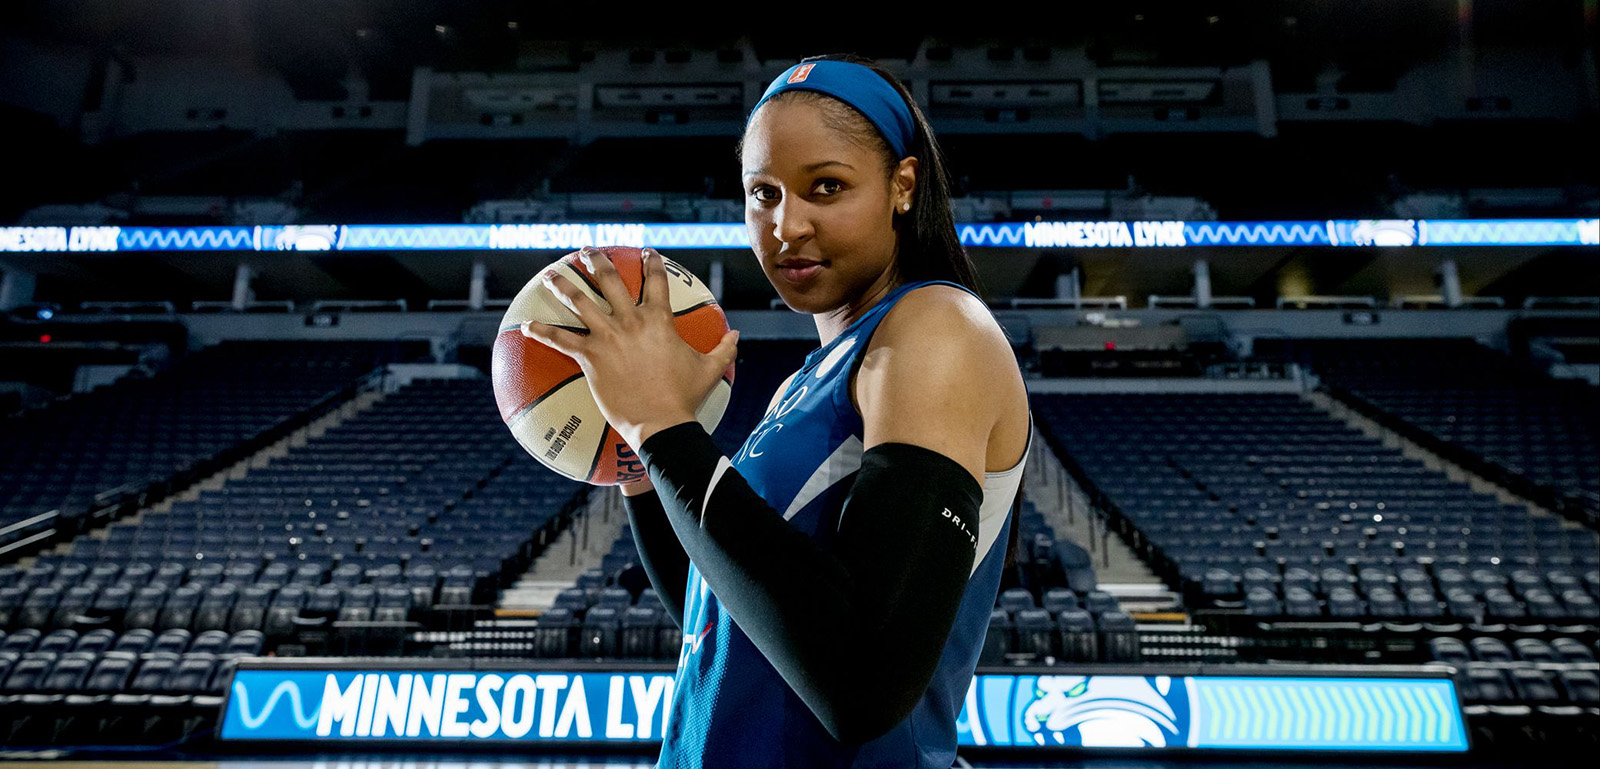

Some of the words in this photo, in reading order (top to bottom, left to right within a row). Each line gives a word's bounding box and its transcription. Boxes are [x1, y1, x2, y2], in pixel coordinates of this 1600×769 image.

[68, 226, 121, 251] LYNX
[489, 223, 593, 249] MINNESOTA
[595, 223, 646, 248] LYNX
[1024, 221, 1133, 247] MINNESOTA
[1133, 221, 1187, 247] LYNX
[616, 443, 647, 483] SPA
[316, 673, 593, 738] MINNESOTA
[605, 675, 676, 739] LY
